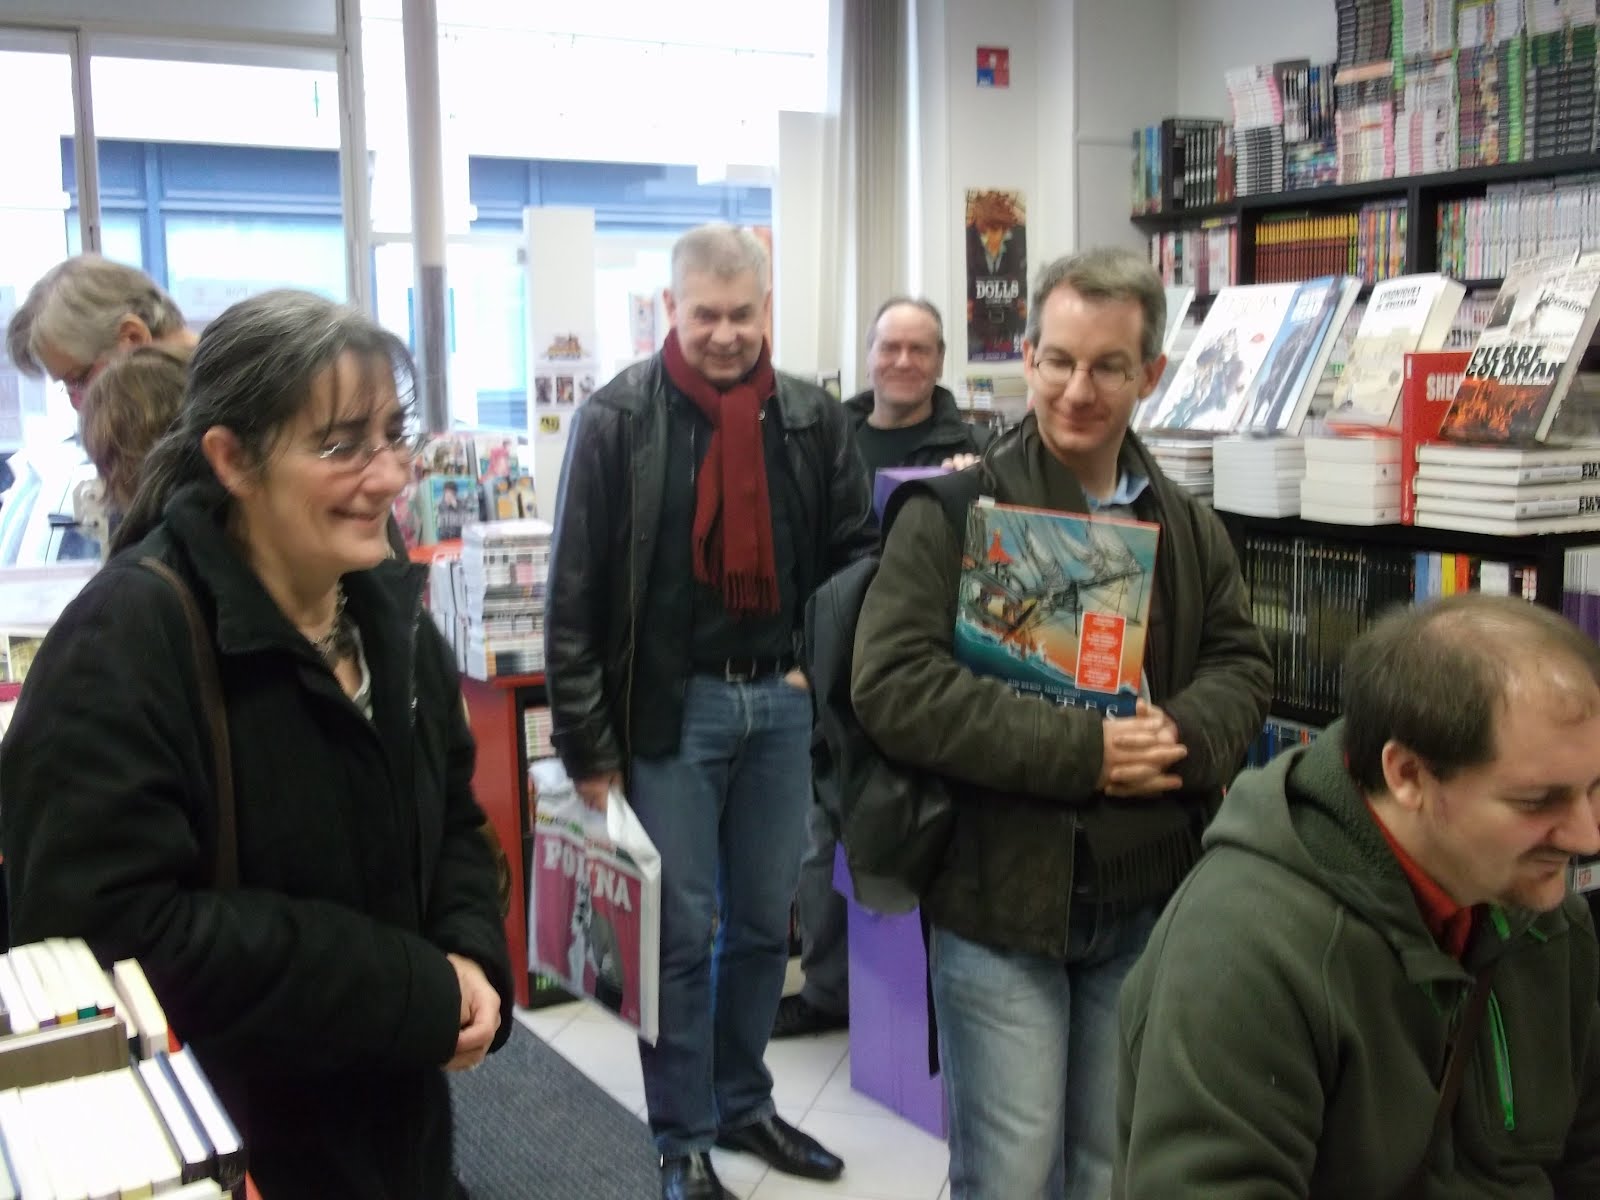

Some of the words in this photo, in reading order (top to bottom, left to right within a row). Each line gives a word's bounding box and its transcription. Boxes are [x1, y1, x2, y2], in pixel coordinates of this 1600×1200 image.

[1539, 289, 1588, 313] Libération
[1472, 345, 1545, 362] PIERRE
[1465, 360, 1566, 378] GOLDMAN
